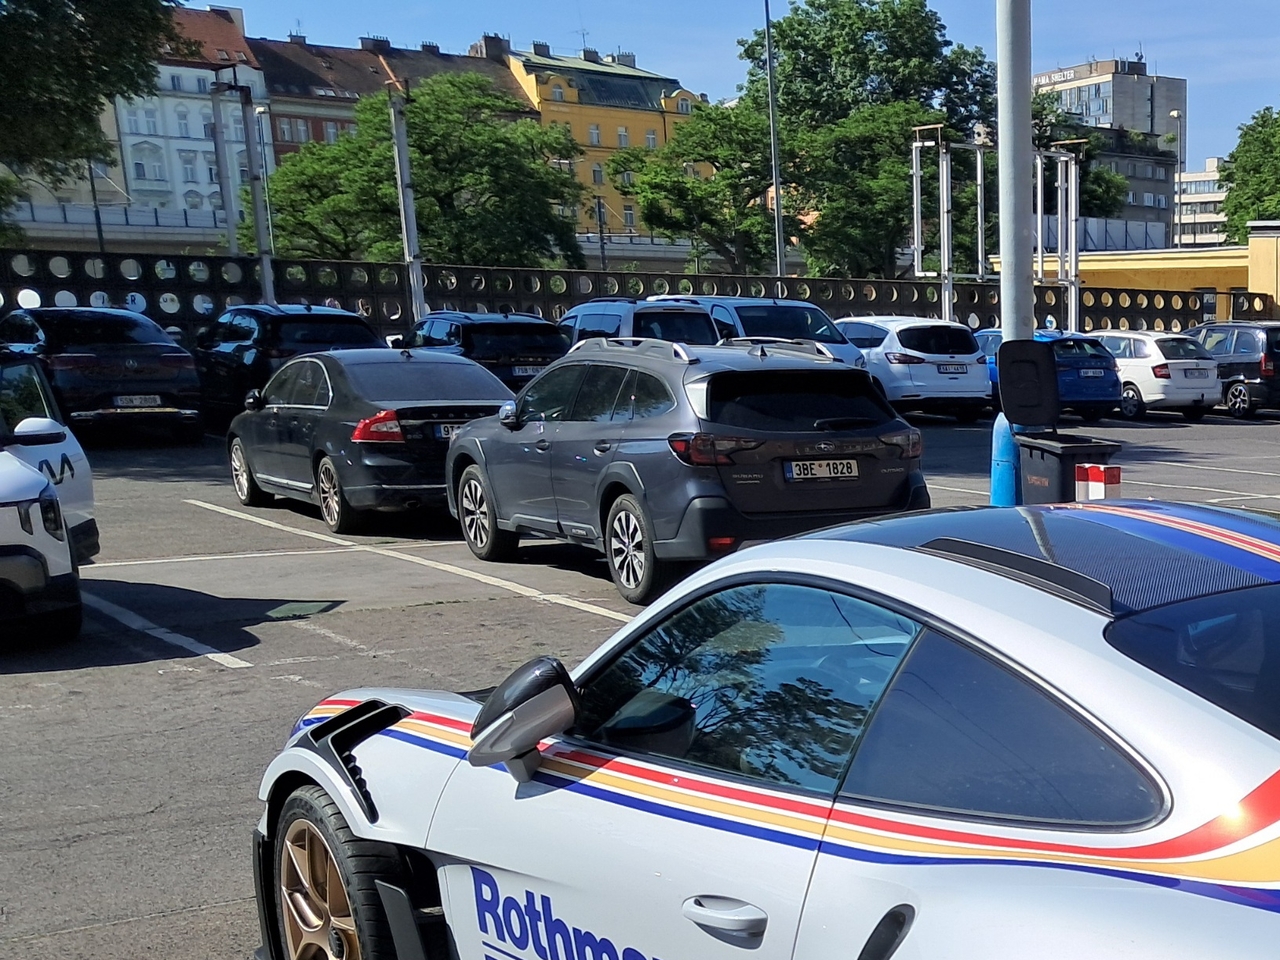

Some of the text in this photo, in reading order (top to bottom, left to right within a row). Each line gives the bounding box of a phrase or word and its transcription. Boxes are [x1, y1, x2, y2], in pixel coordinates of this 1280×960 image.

[1033, 70, 1075, 85] MAMA SHELTER
[795, 461, 854, 476] 3BE 1828
